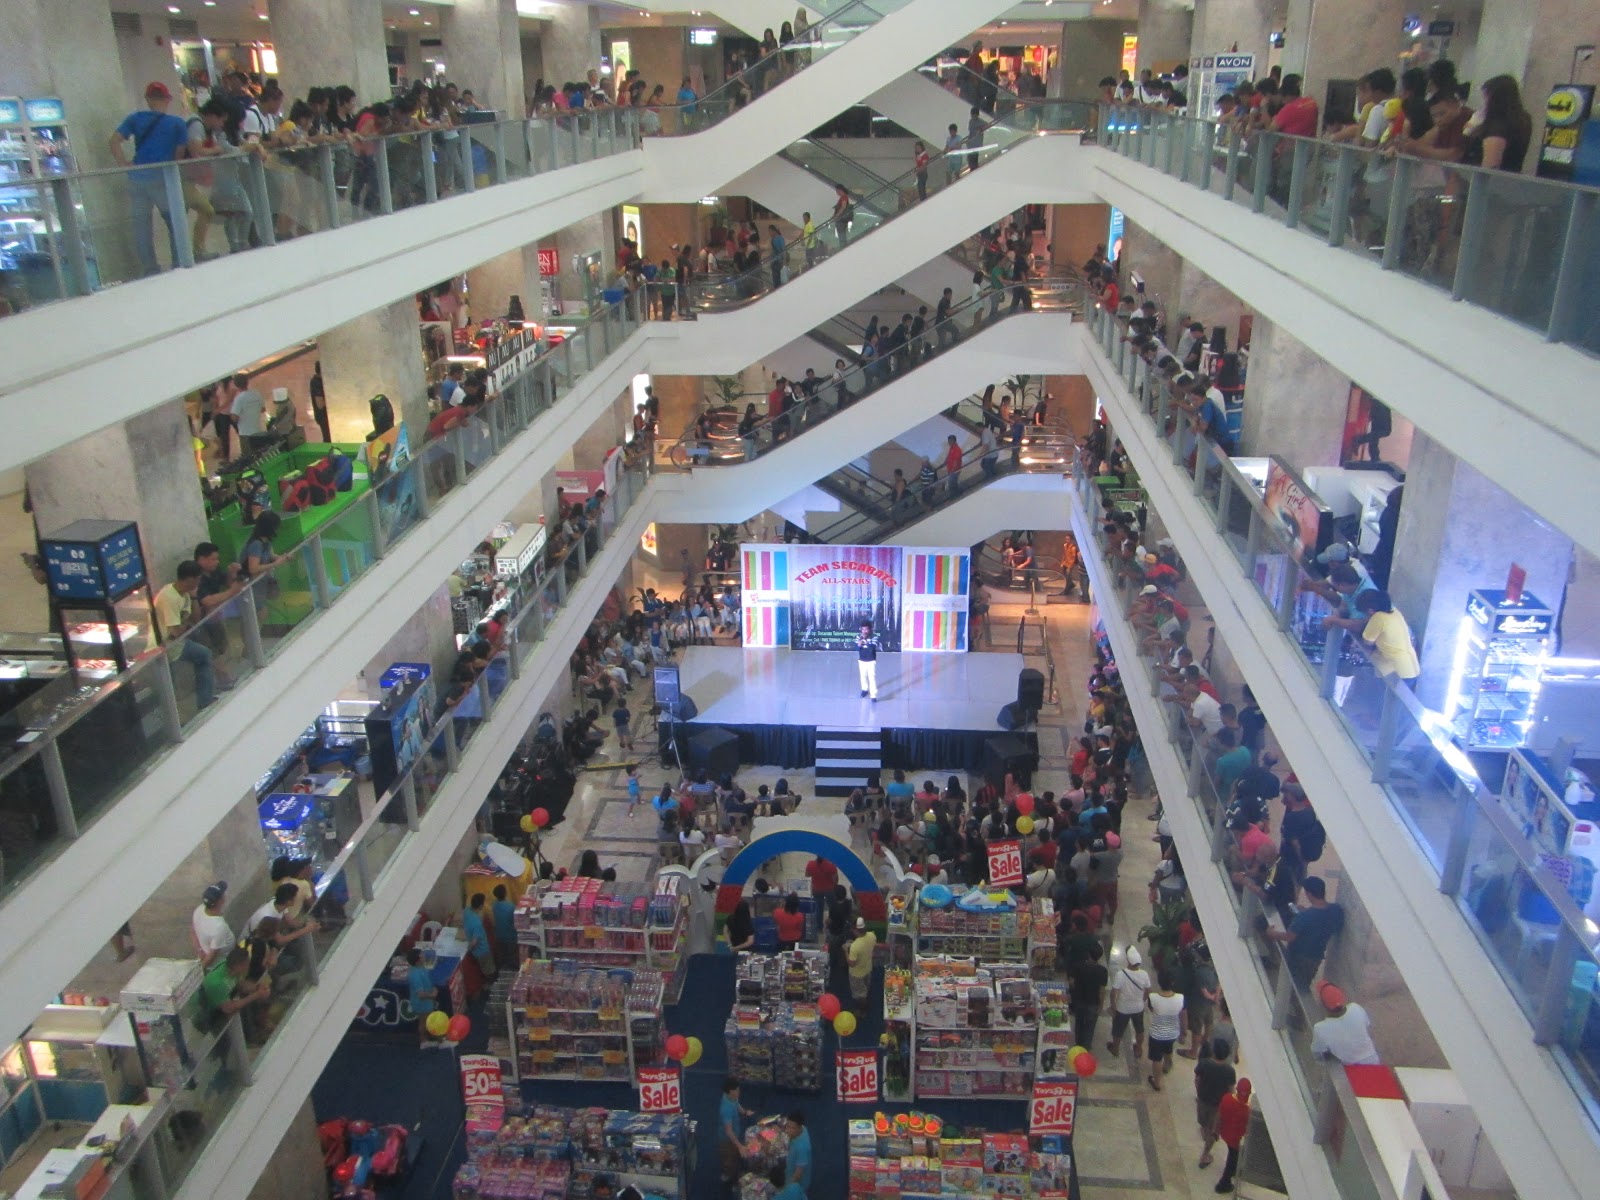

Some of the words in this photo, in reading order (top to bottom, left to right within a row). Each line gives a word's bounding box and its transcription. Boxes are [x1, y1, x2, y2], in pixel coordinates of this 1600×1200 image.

[1219, 58, 1250, 66] AVON
[794, 563, 830, 584] TEAM
[831, 561, 897, 588] SECARATS
[991, 853, 1020, 878] Sale
[839, 1066, 876, 1093] Sale
[642, 1083, 679, 1109] Sale
[1033, 1098, 1072, 1125] Sale
